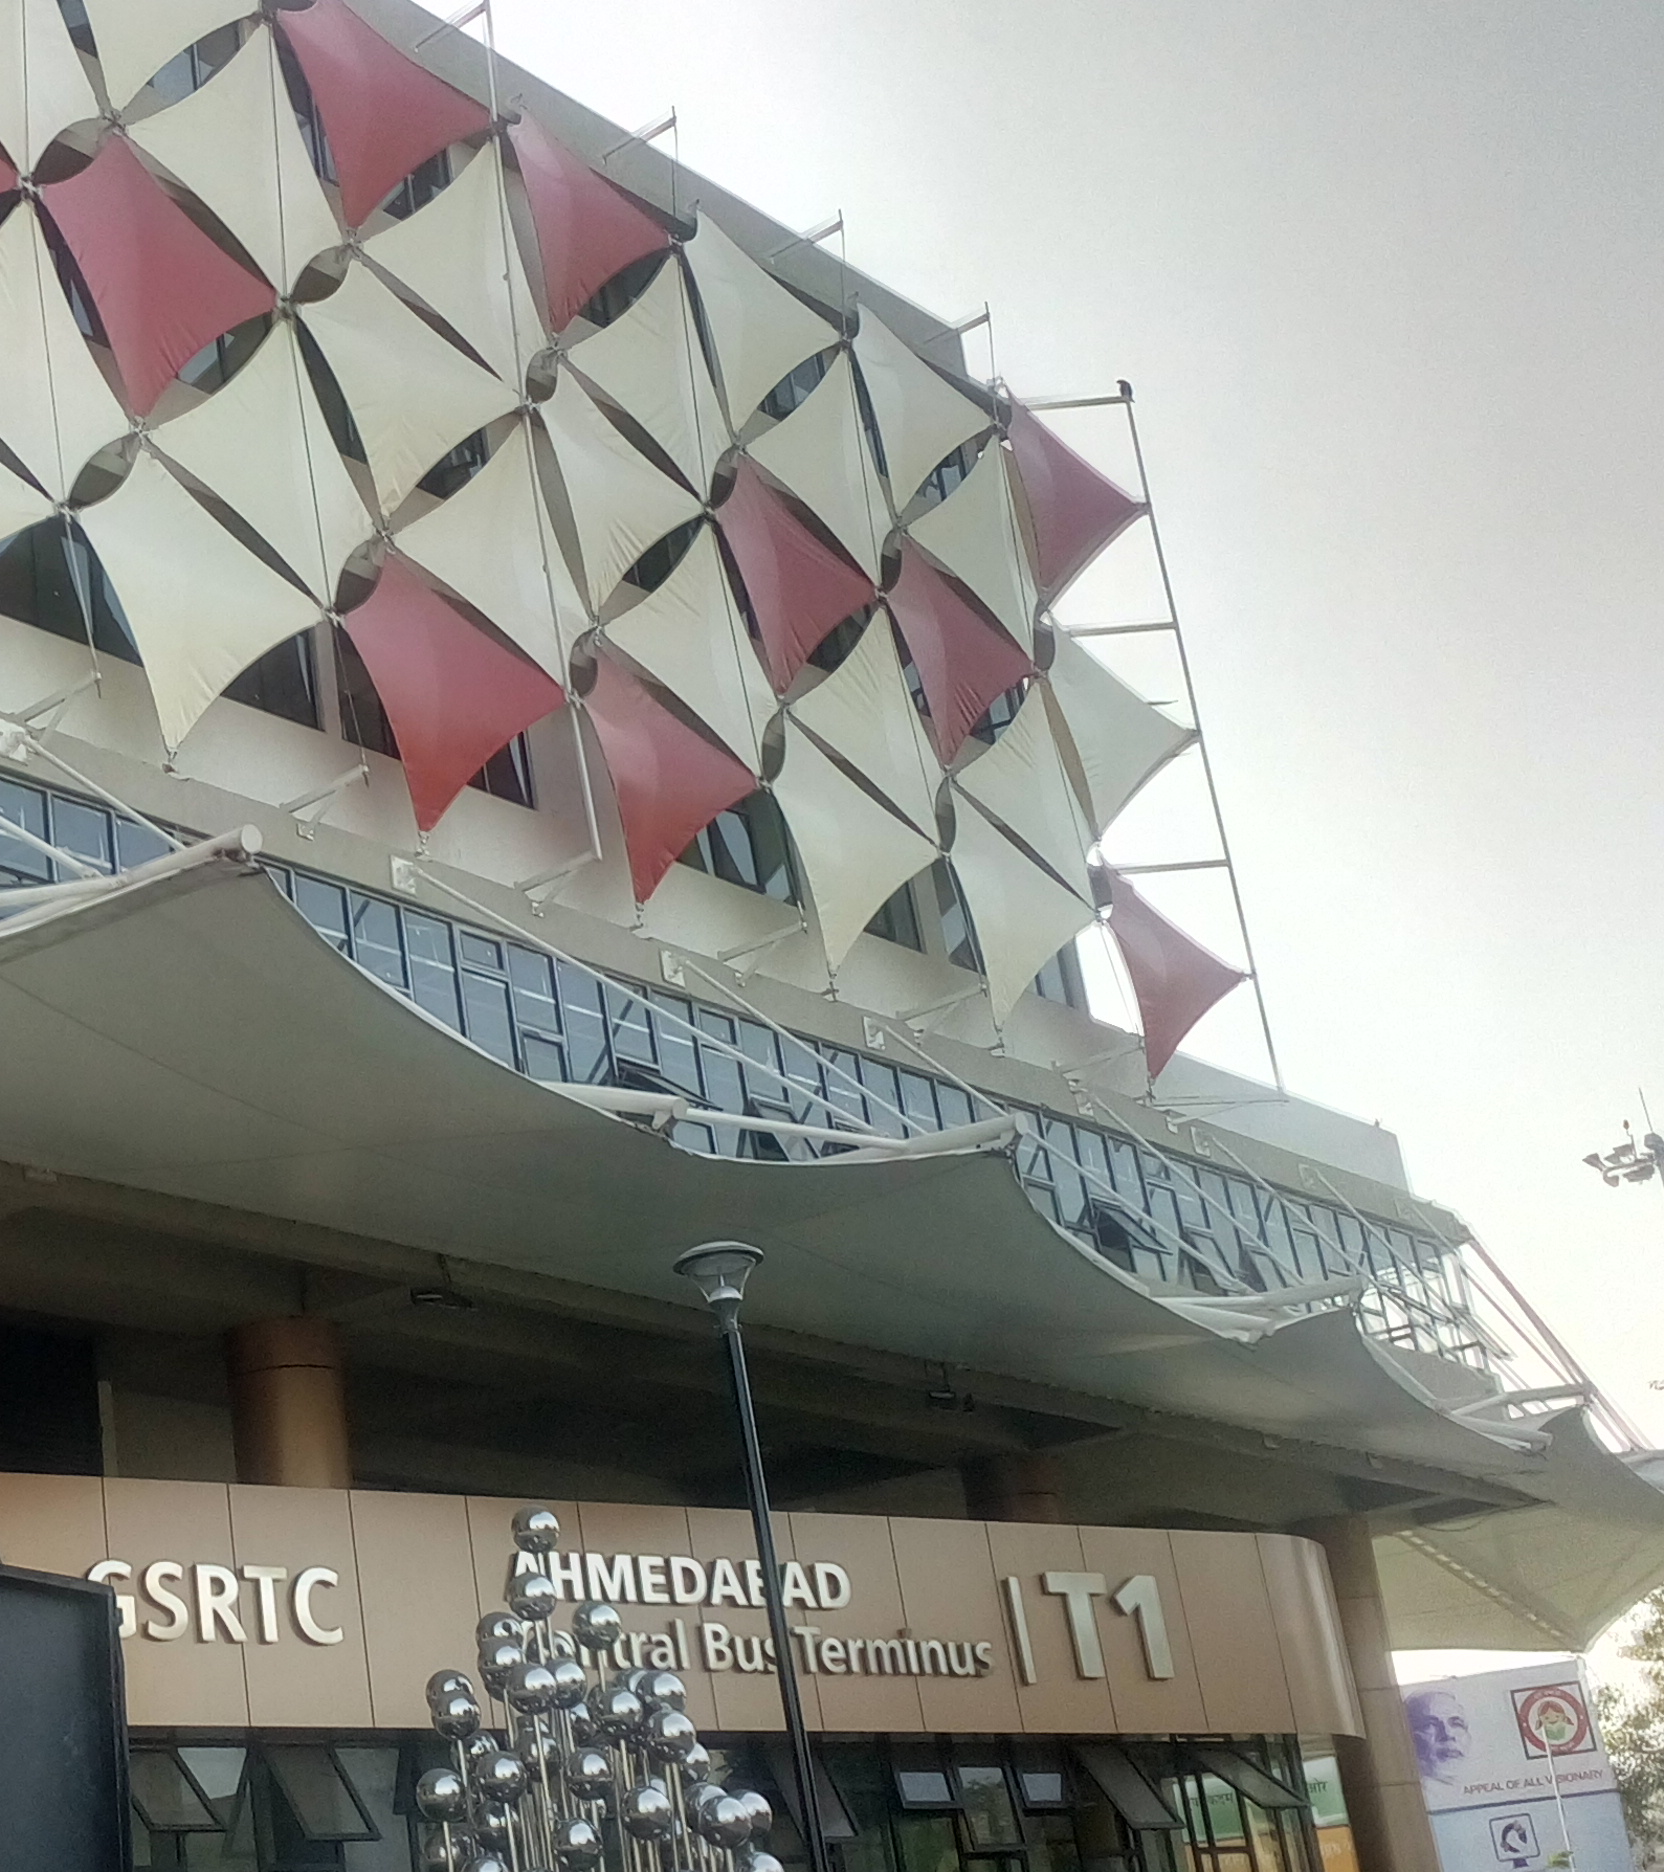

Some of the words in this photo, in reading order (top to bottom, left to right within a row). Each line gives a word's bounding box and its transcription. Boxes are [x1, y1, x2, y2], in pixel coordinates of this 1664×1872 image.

[86, 1558, 345, 1645] GSRTC
[1042, 1571, 1175, 1679] T1
[521, 1617, 691, 1671] ntral
[791, 1625, 994, 1677] Terminus
[1463, 1782, 1504, 1795] APPEAL
[1506, 1779, 1520, 1790] OF
[1523, 1777, 1543, 1787] ALL
[1545, 1769, 1603, 1785] VSIONARY
